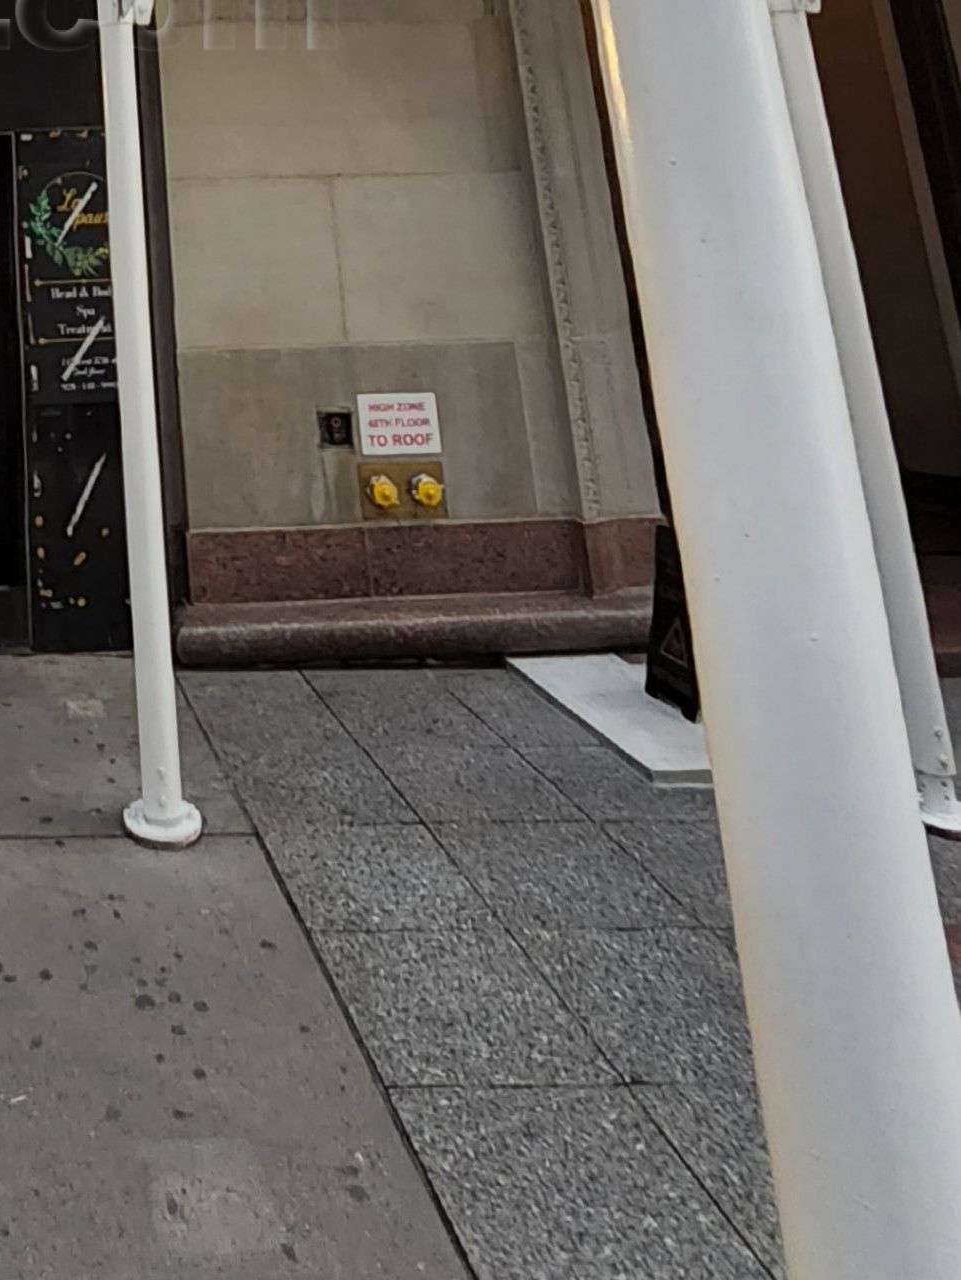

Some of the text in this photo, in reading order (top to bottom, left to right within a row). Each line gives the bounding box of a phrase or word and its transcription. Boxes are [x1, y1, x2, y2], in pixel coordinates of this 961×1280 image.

[367, 401, 426, 413] HIGH ZONE
[394, 417, 431, 428] FLOOR
[366, 432, 434, 448] TO ROOF
